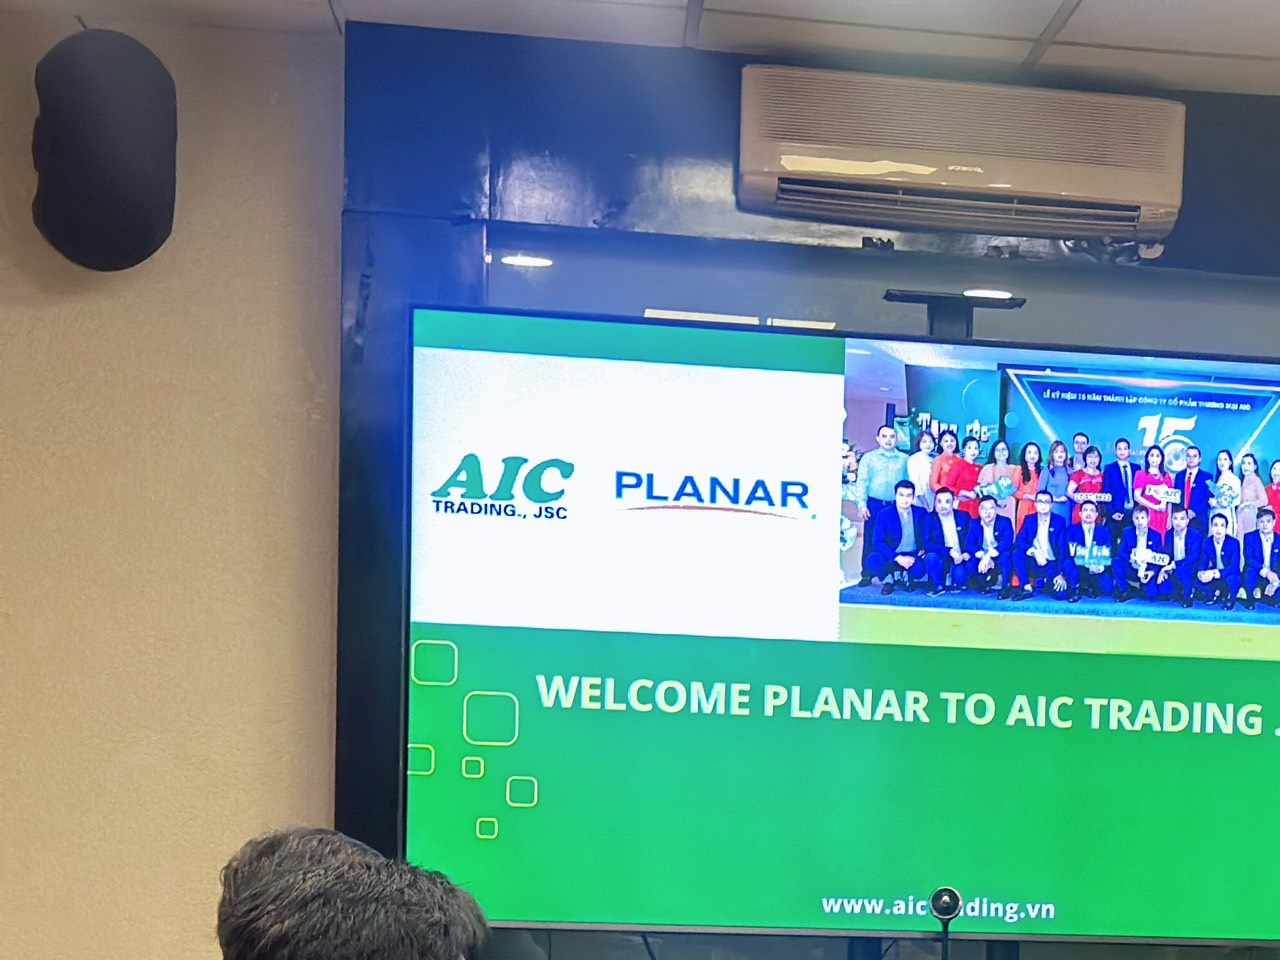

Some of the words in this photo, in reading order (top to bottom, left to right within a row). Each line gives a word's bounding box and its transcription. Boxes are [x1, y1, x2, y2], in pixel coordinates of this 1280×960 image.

[431, 453, 574, 504] AIC
[615, 470, 809, 509] PLANAR
[533, 505, 568, 520] JSC
[536, 674, 751, 715] WELCOME
[764, 684, 931, 723] PLANAR
[939, 692, 996, 725] TO
[1006, 694, 1074, 729] AIC
[1084, 698, 1264, 735] TRADING
[822, 894, 1056, 924] www.aicding.vn
